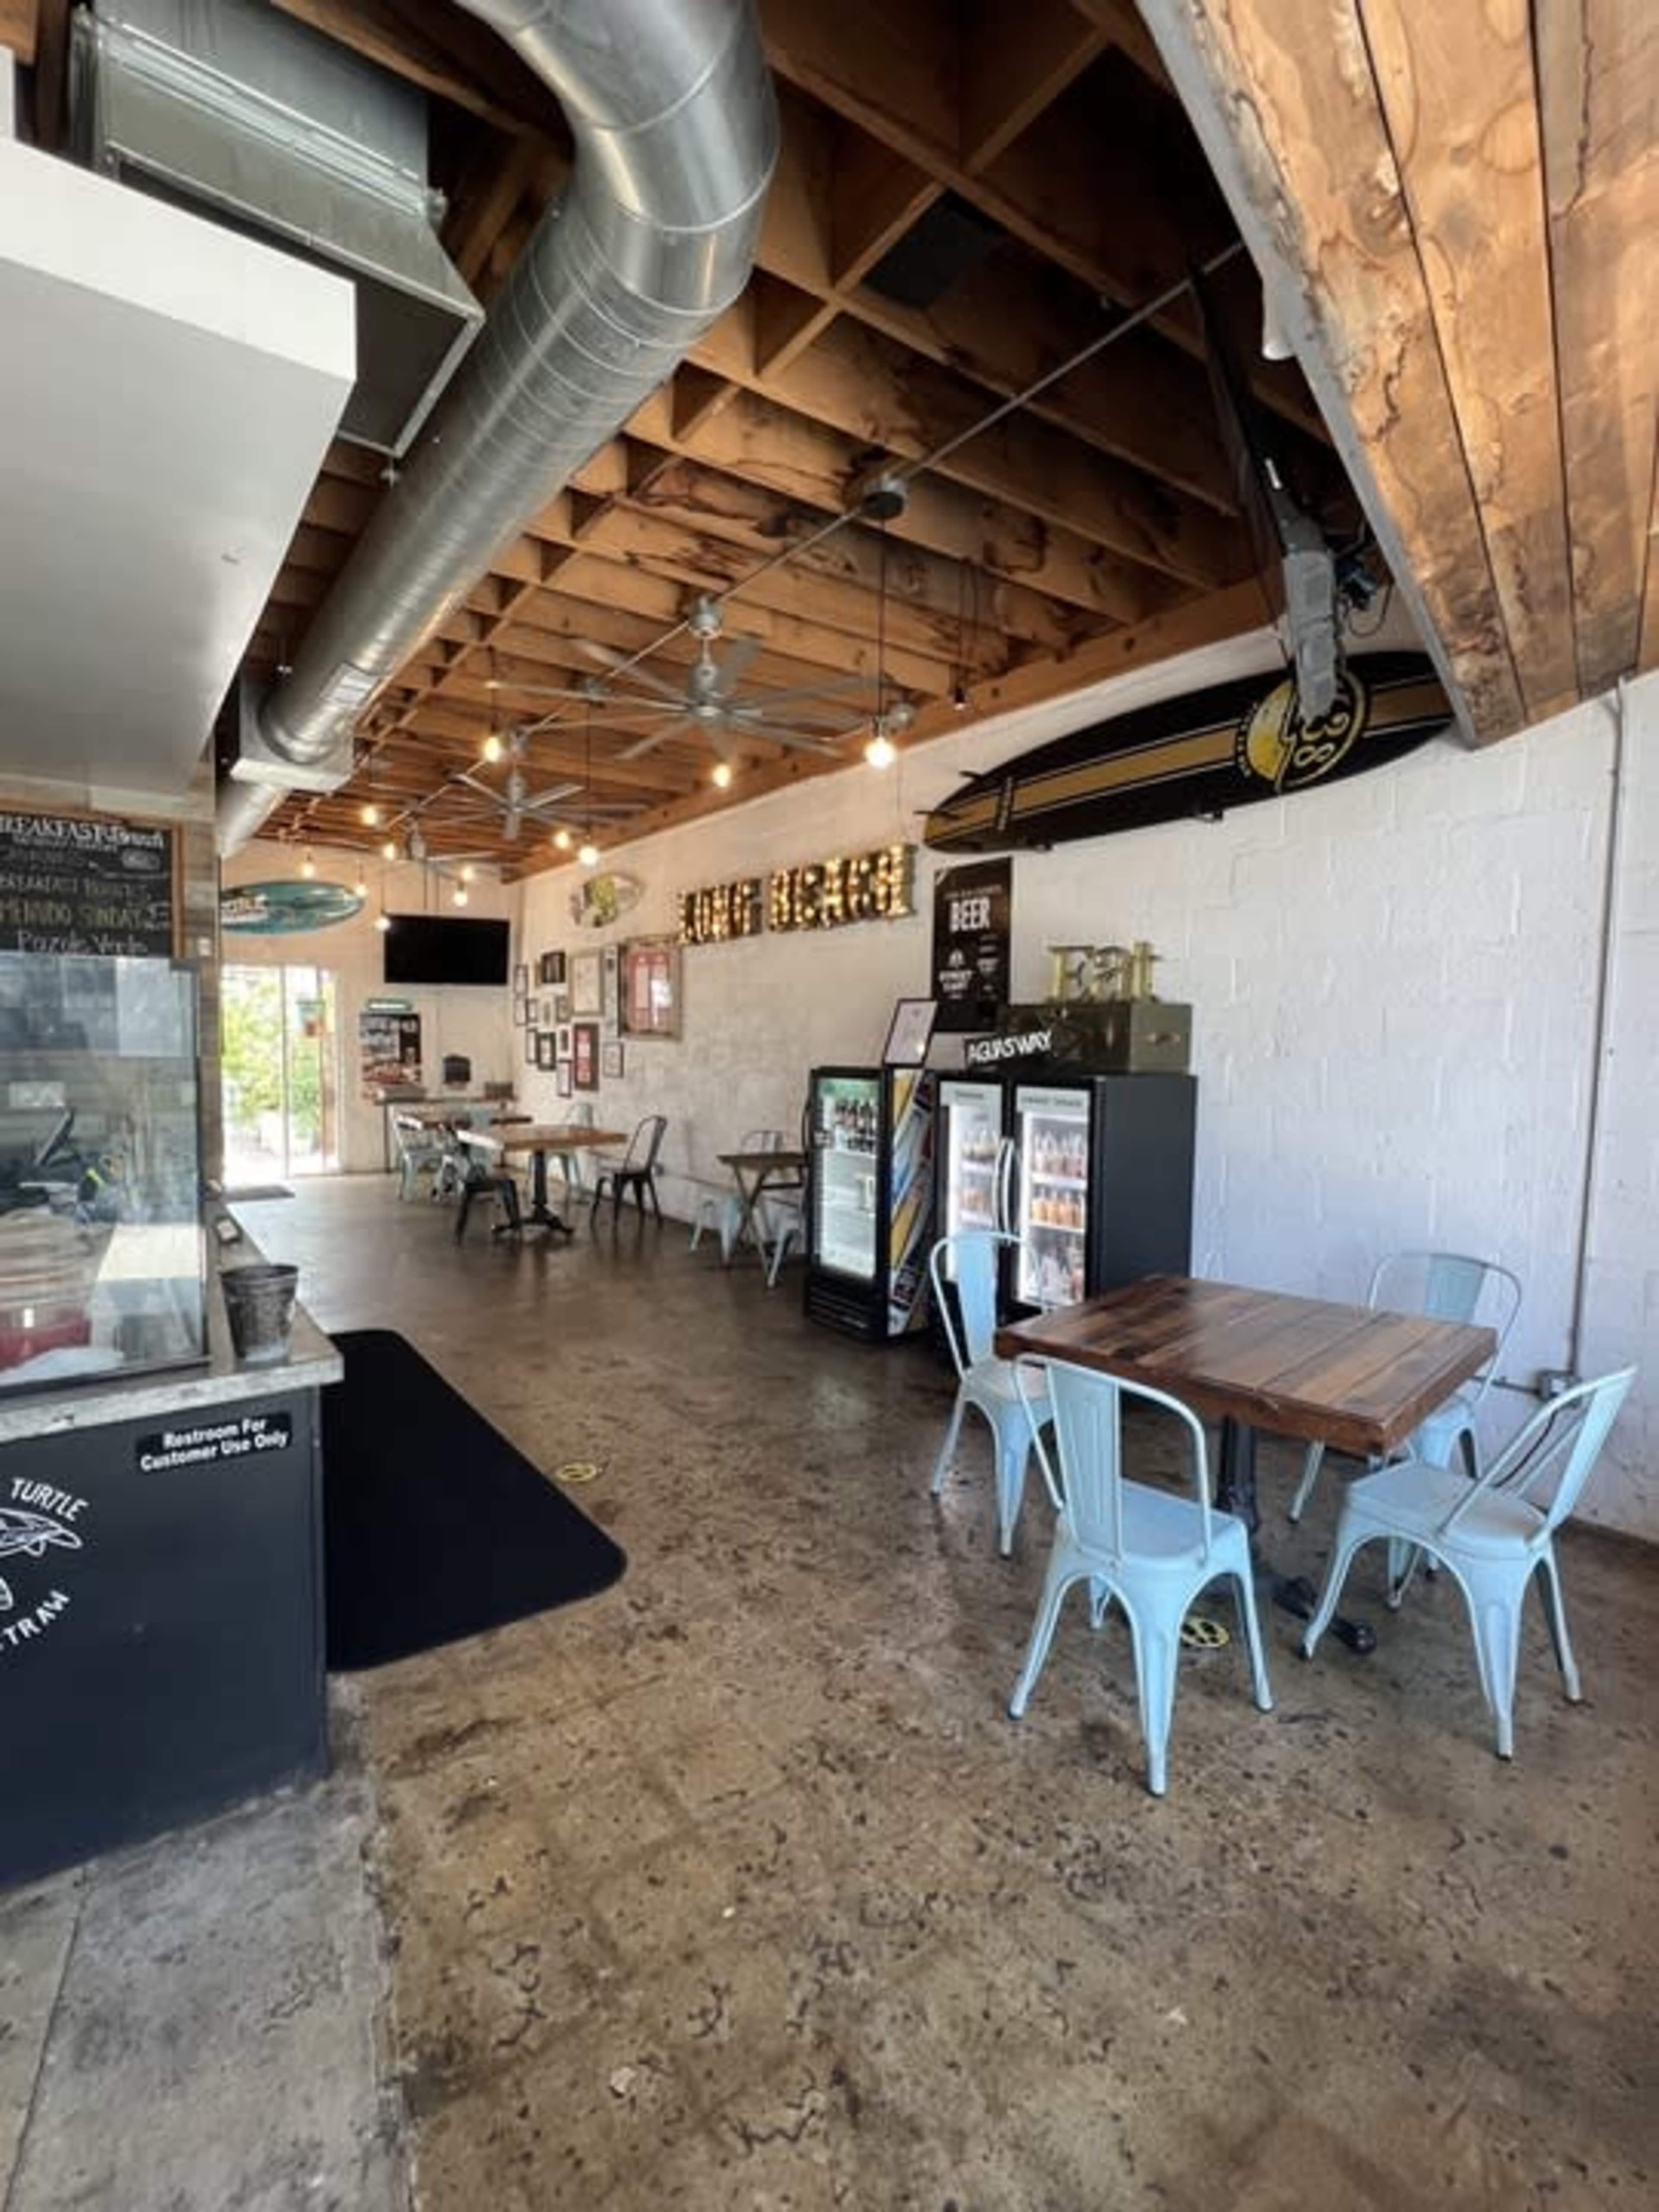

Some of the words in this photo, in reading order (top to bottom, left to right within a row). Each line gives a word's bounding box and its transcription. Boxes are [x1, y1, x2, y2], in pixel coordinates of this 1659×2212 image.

[769, 842, 916, 932] BEACH
[950, 896, 991, 932] BEER
[140, 1446, 217, 1471] Customer
[220, 1439, 251, 1455] Use
[254, 1429, 289, 1449] Only
[162, 1424, 239, 1449] Restroom
[242, 1418, 267, 1434] For
[10, 1478, 89, 1522] TURTLE
[0, 1590, 70, 1651] TRAW
